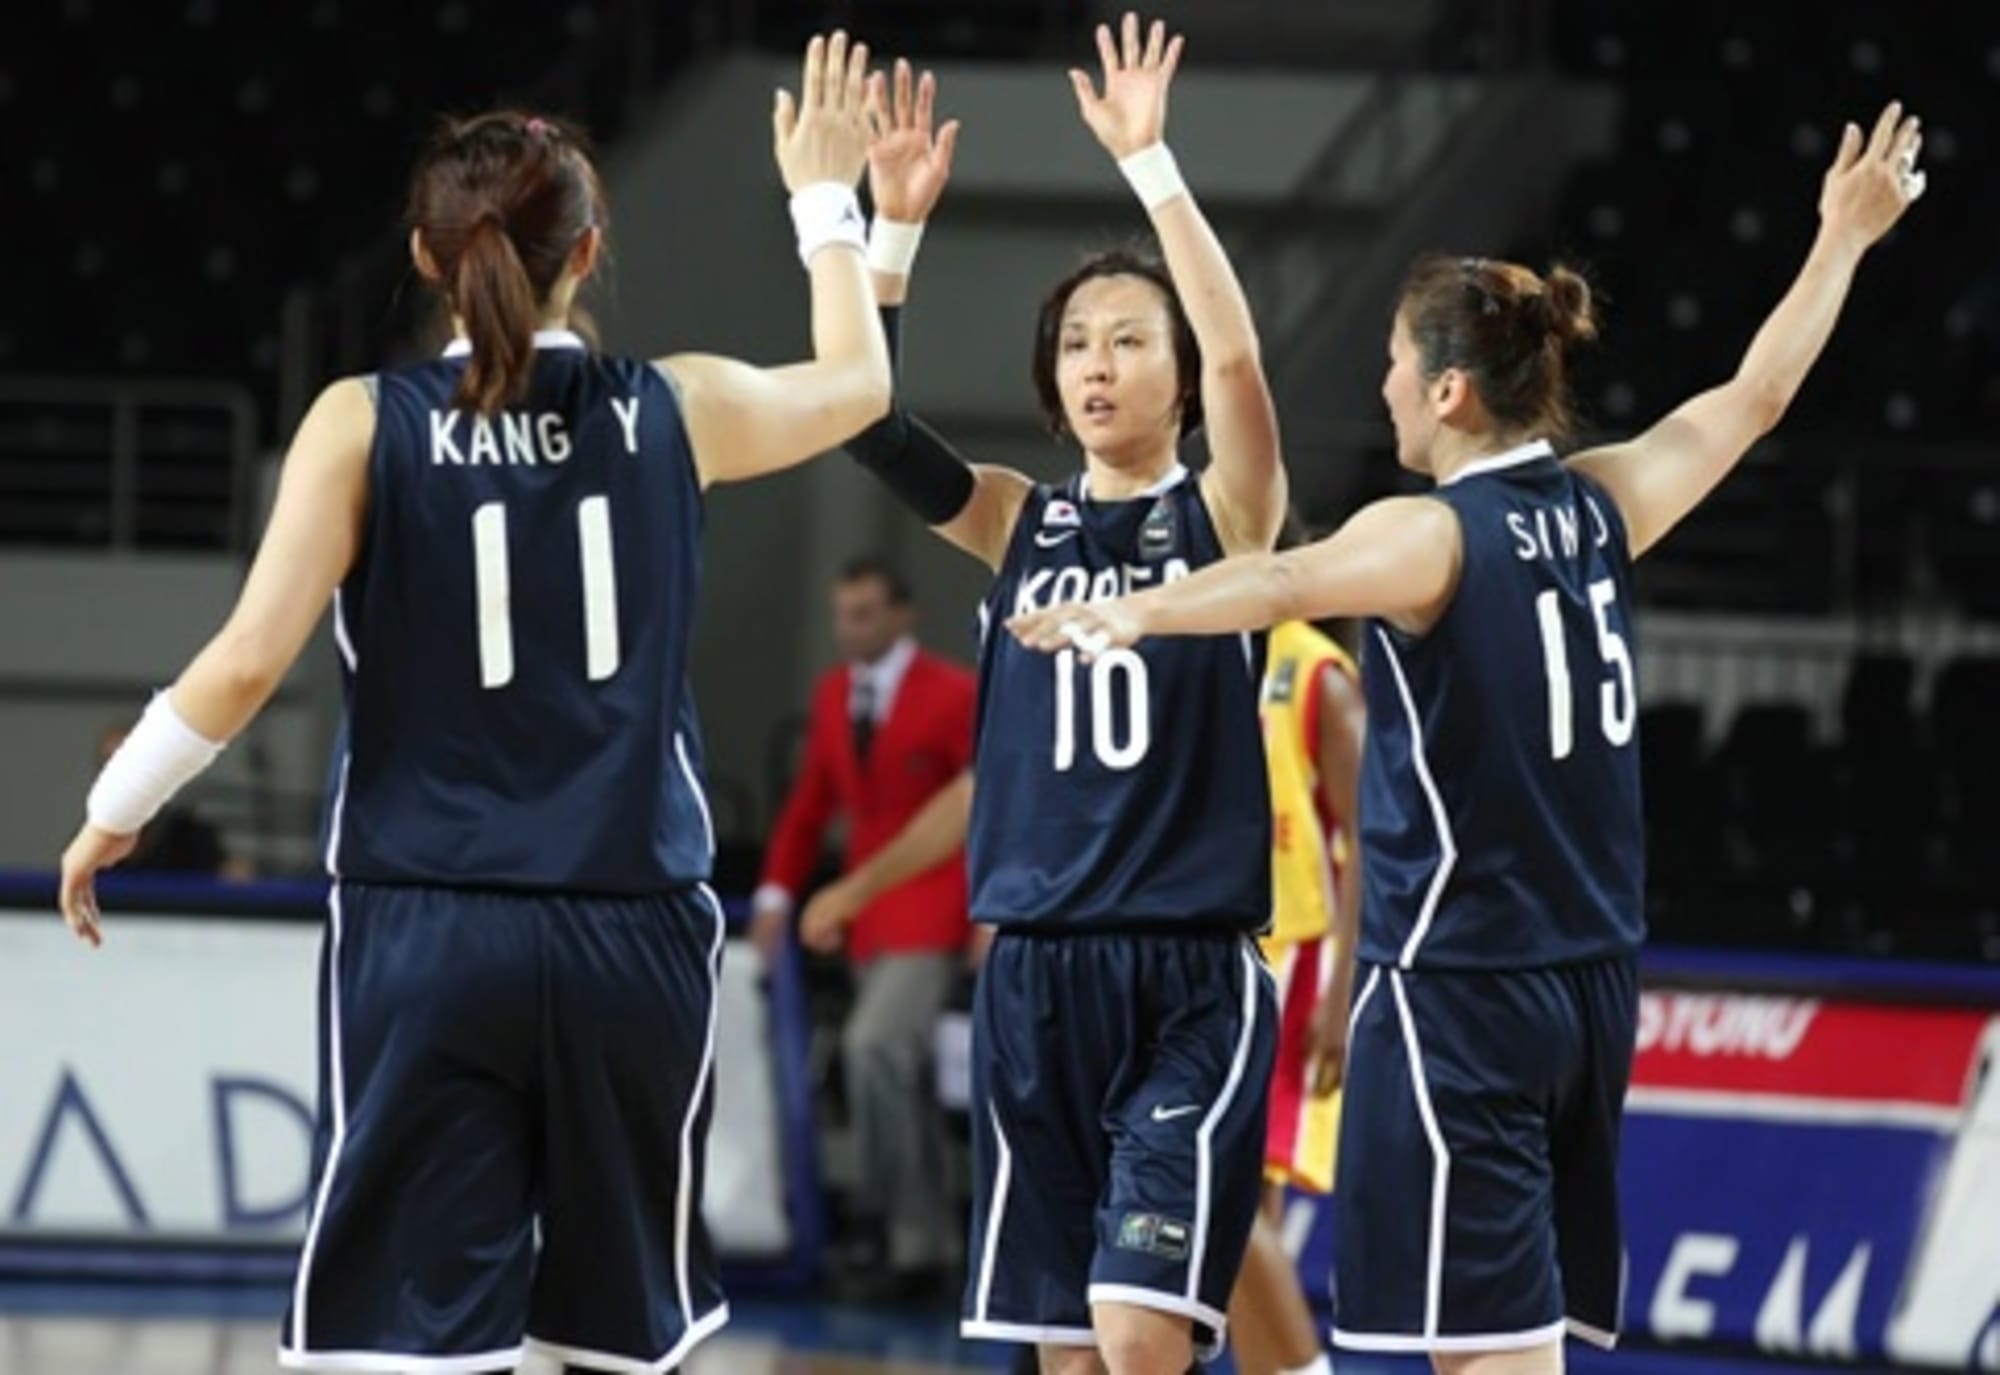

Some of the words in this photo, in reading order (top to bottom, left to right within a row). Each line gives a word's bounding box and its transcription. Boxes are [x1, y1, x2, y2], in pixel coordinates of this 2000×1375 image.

[429, 408, 572, 466] KANG
[610, 396, 639, 453] Y
[472, 495, 620, 689] 11
[1535, 577, 1636, 760] 15
[1054, 647, 1150, 772] 10
